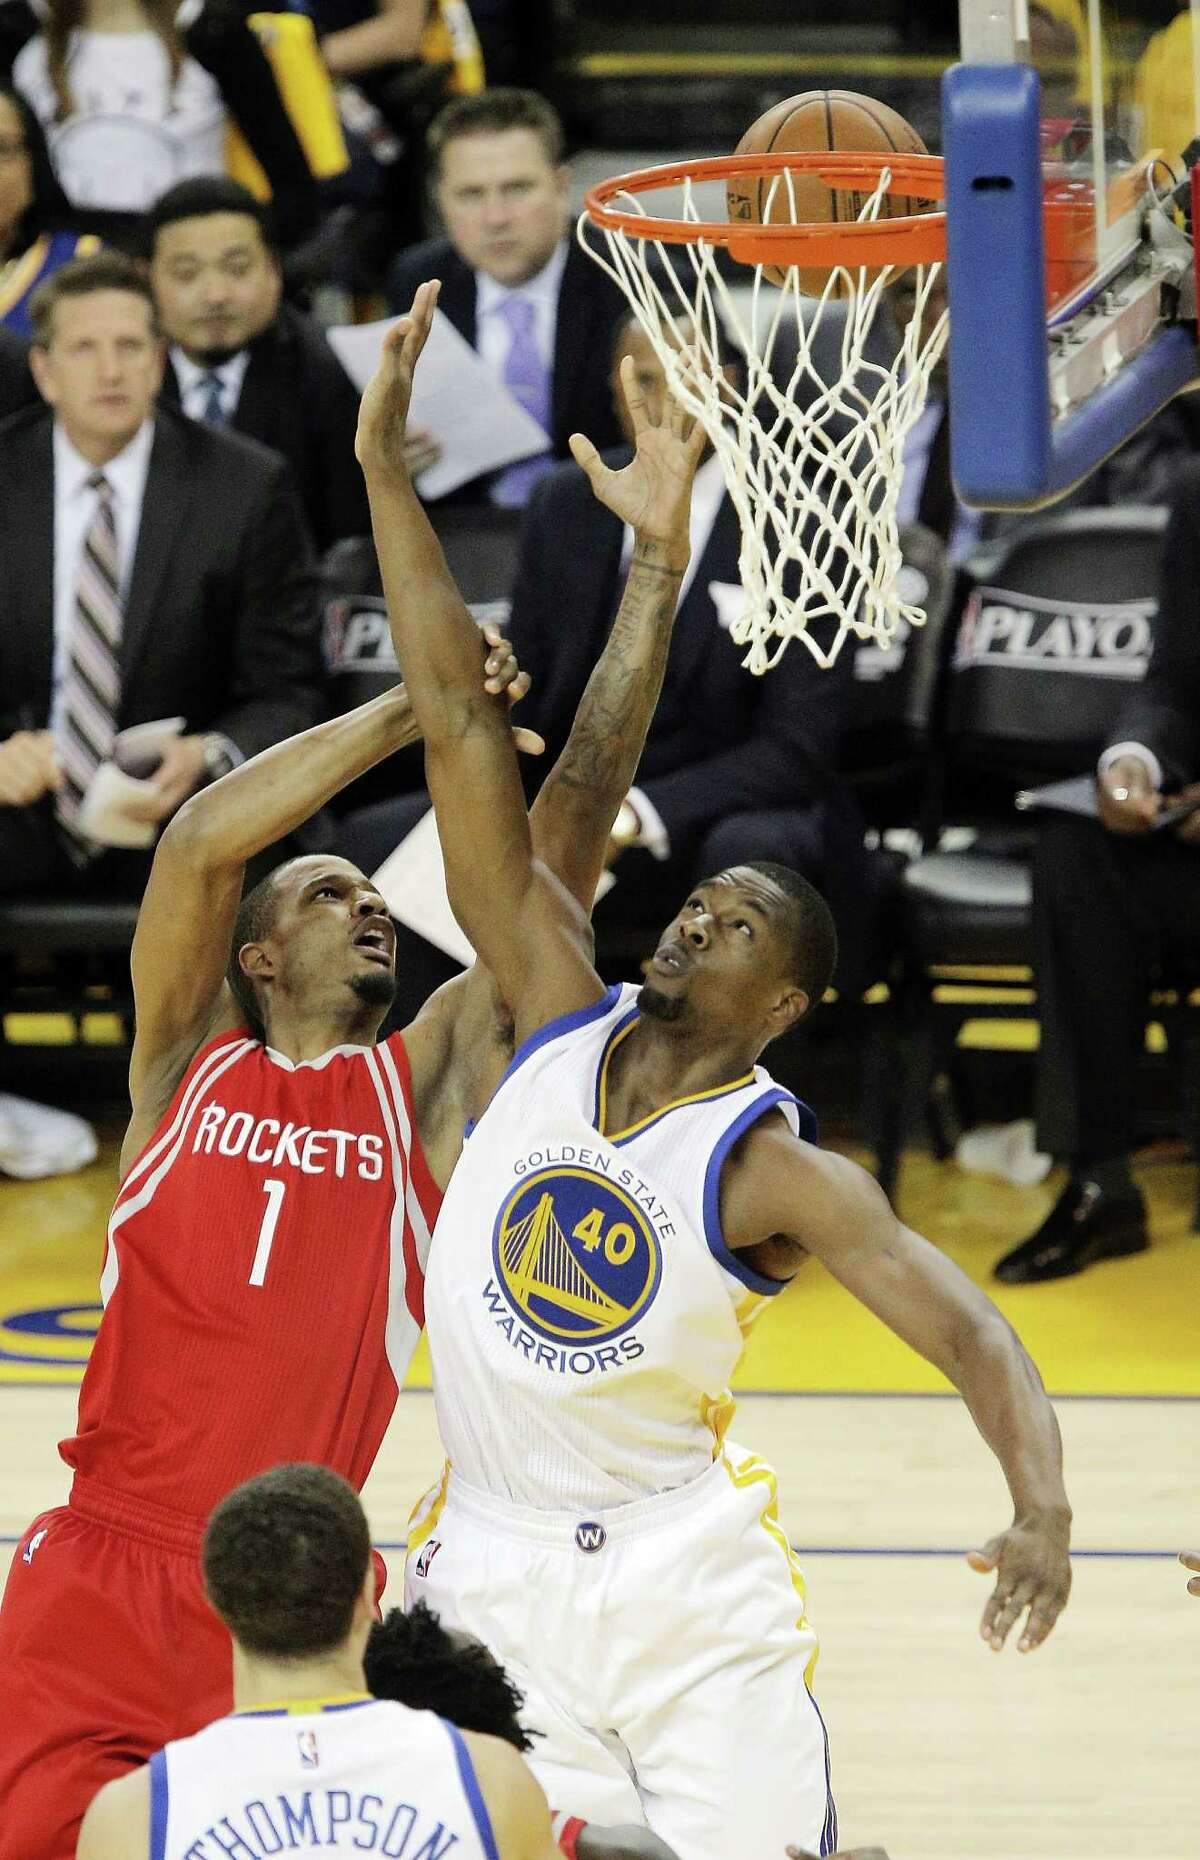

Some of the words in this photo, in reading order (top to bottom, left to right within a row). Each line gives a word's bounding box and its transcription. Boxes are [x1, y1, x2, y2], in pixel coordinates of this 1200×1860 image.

[974, 605, 1153, 658] PLAYO
[192, 1100, 384, 1181] ROCKETS
[248, 1178, 286, 1287] 1
[513, 1146, 612, 1176] GOLDEN
[617, 1168, 677, 1240] STATE
[571, 1207, 637, 1266] 40
[481, 1278, 646, 1376] WARRIORS
[577, 1527, 602, 1548] W
